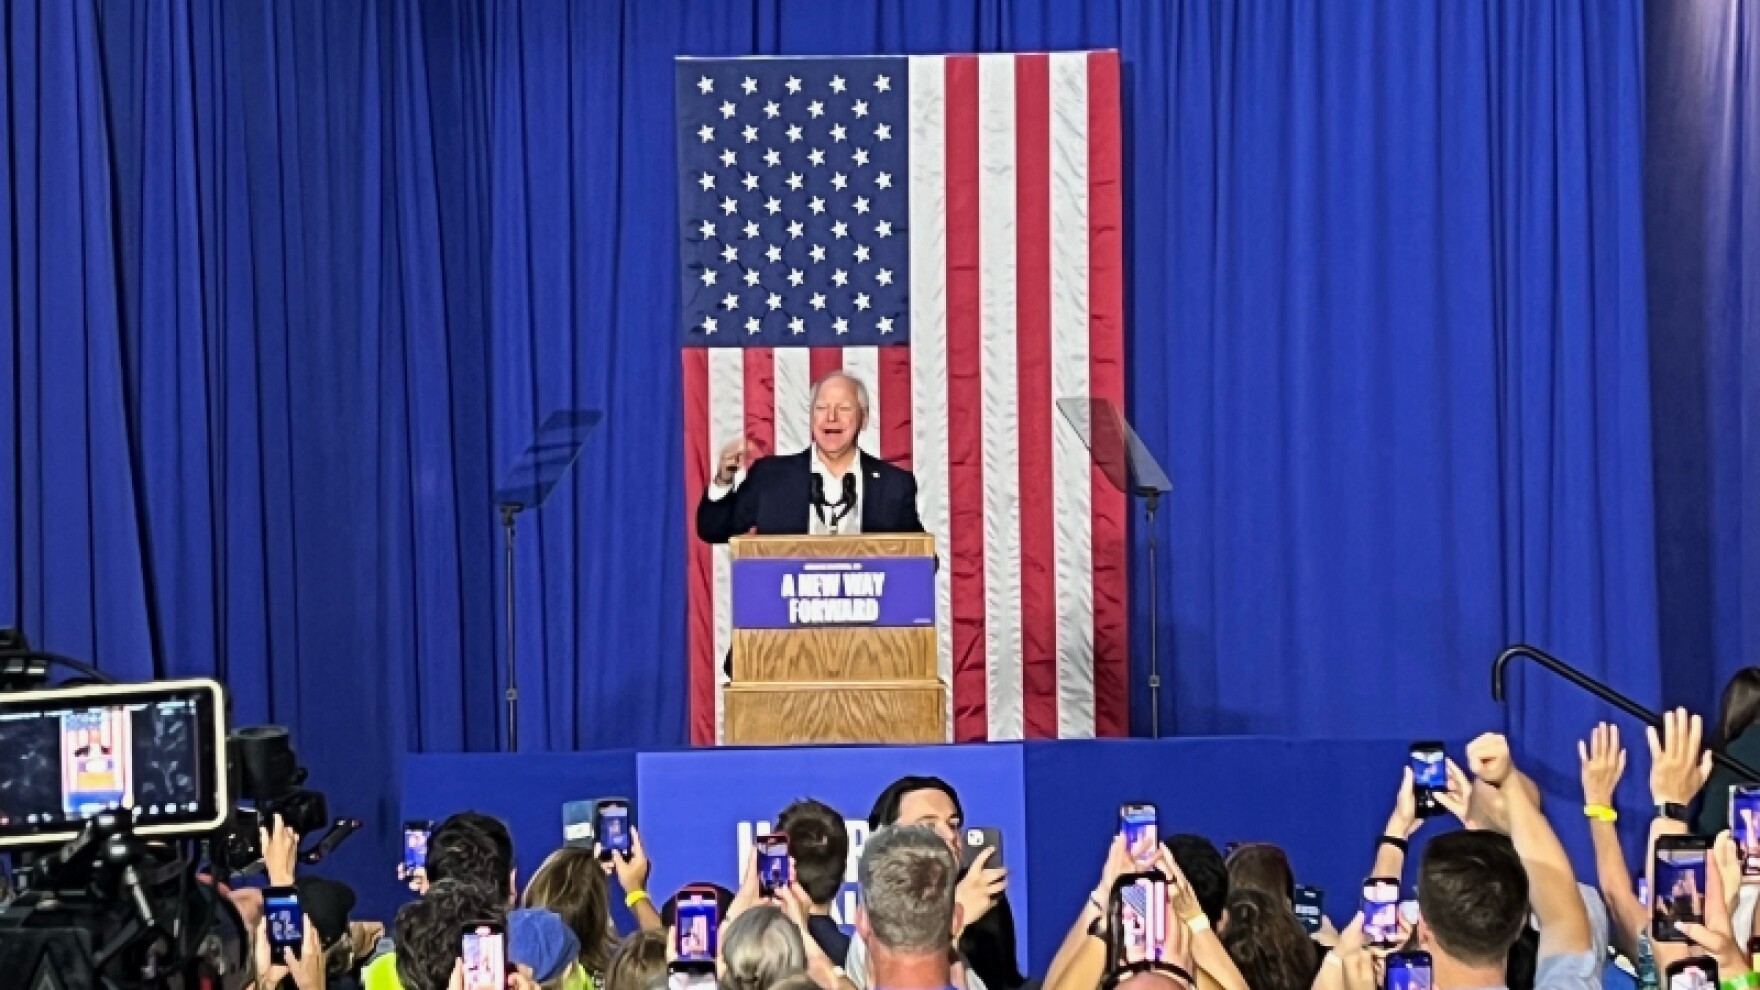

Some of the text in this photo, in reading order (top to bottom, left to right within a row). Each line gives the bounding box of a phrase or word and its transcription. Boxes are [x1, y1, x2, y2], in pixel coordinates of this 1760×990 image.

[781, 571, 885, 597] A NEW WAY
[789, 598, 879, 624] FORWARD
